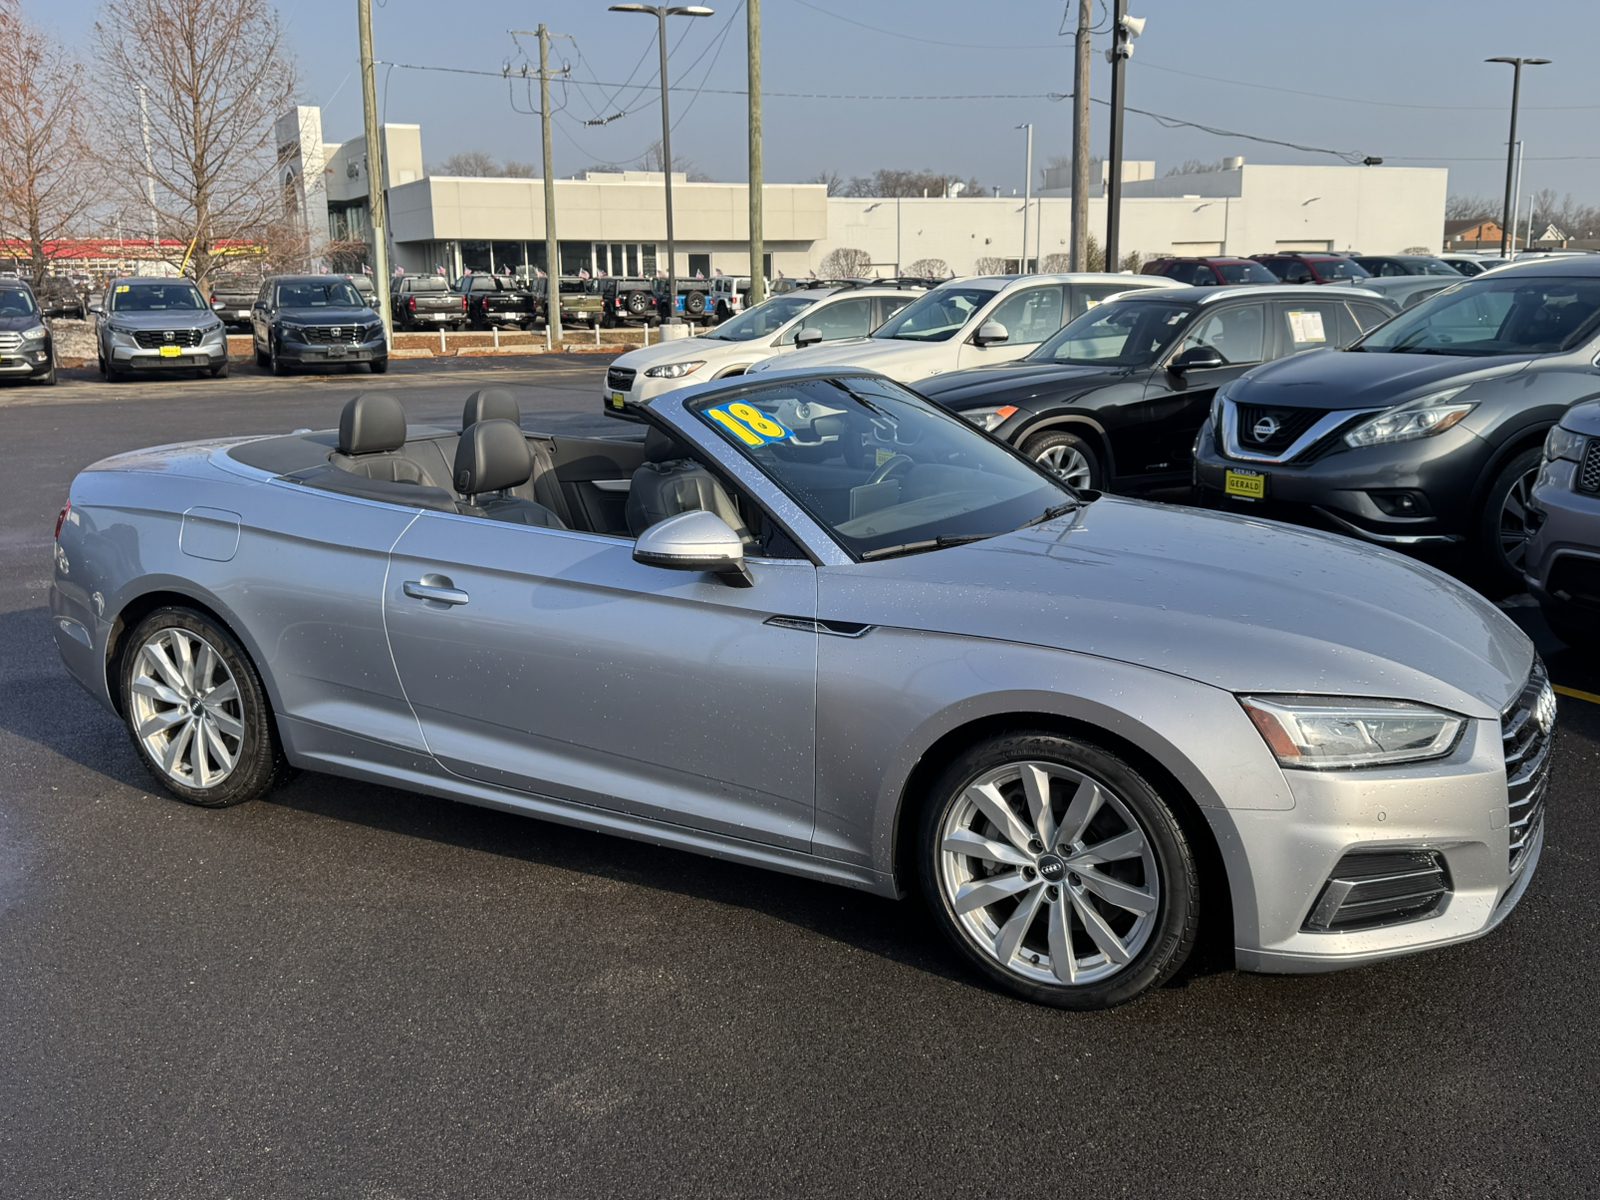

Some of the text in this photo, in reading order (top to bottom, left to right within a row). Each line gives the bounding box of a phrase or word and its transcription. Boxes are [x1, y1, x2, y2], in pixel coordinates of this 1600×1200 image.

[708, 403, 786, 446] 18
[1233, 467, 1257, 477] GERALD
[1230, 479, 1259, 490] GERALD
